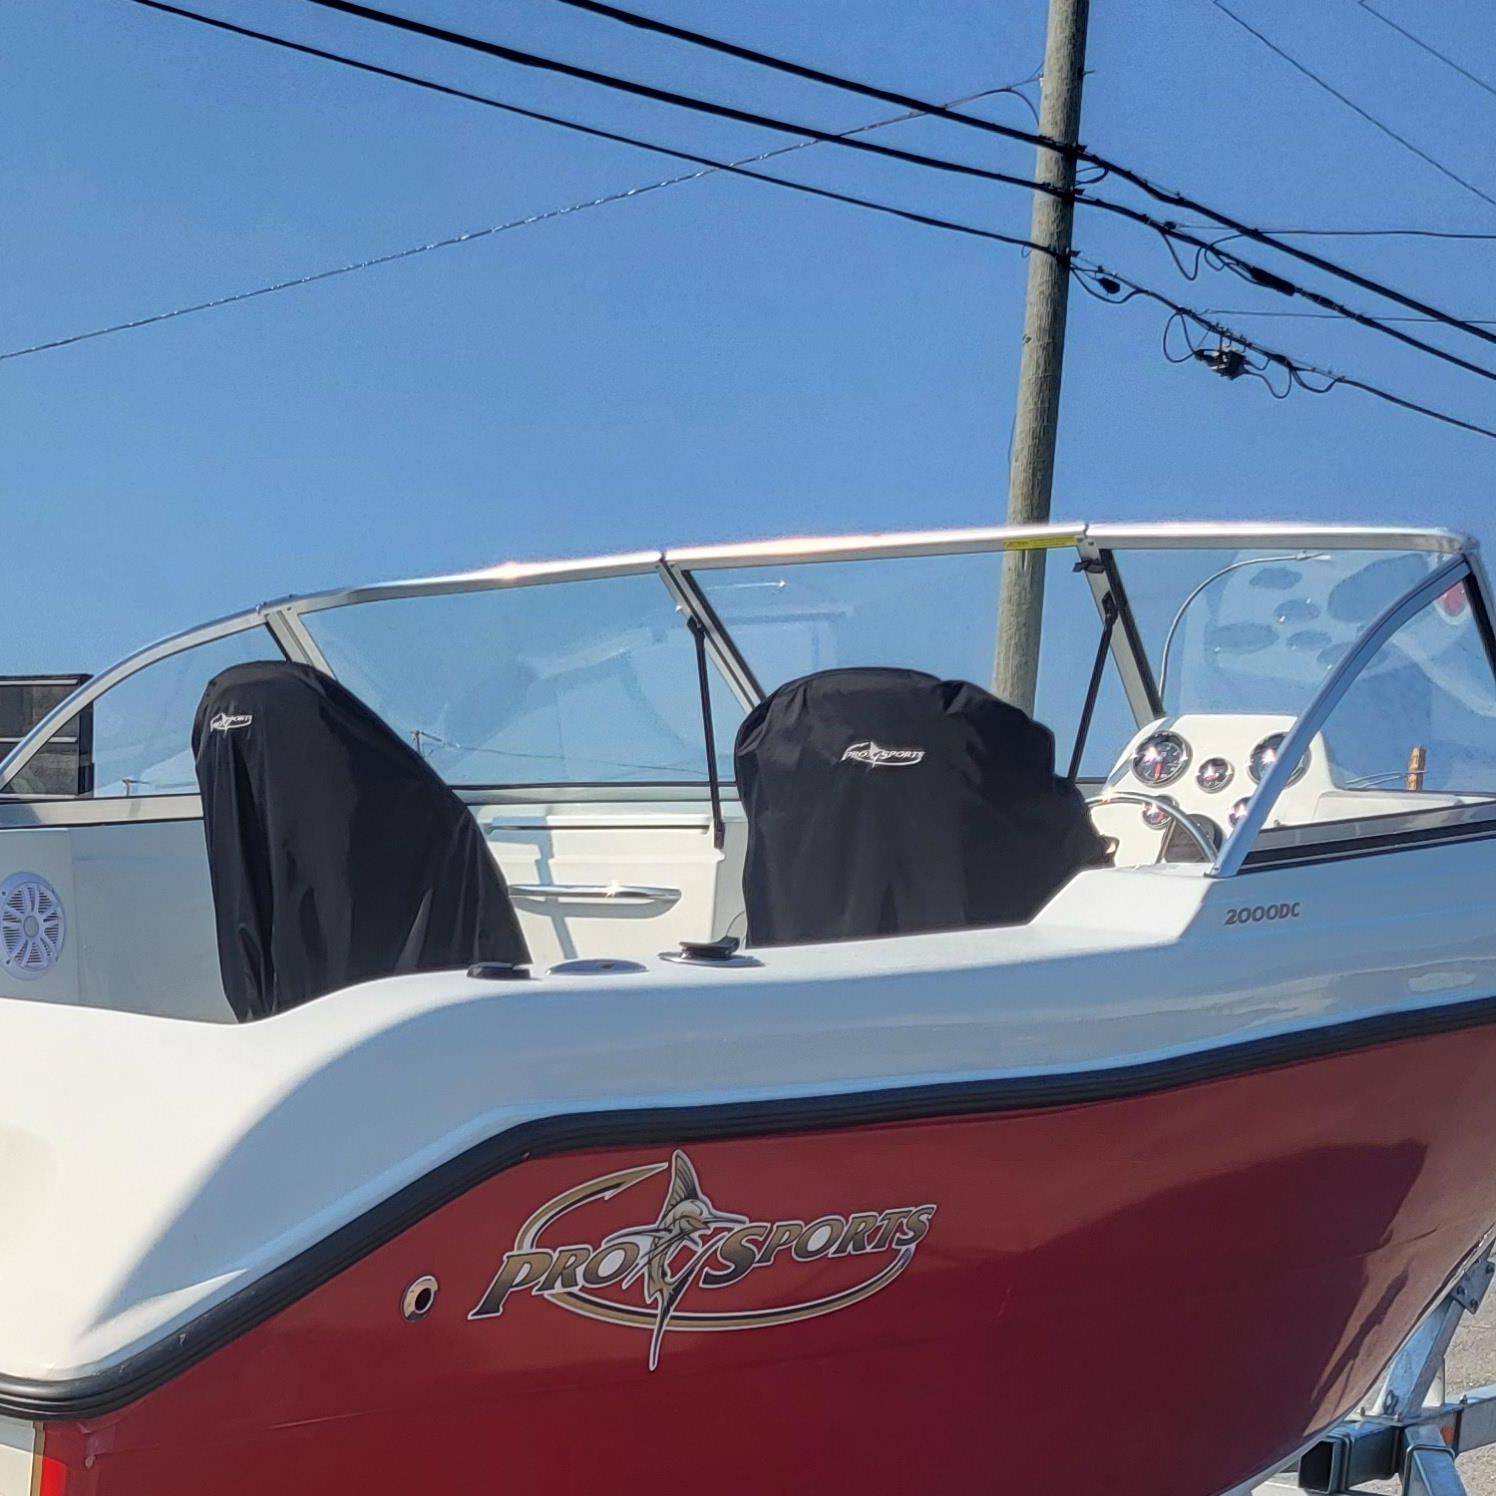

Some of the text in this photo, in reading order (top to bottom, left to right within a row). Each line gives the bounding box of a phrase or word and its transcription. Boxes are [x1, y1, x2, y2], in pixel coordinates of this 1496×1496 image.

[1224, 902, 1301, 926] 2000DC
[468, 1203, 937, 1320] PRO SPORTS
